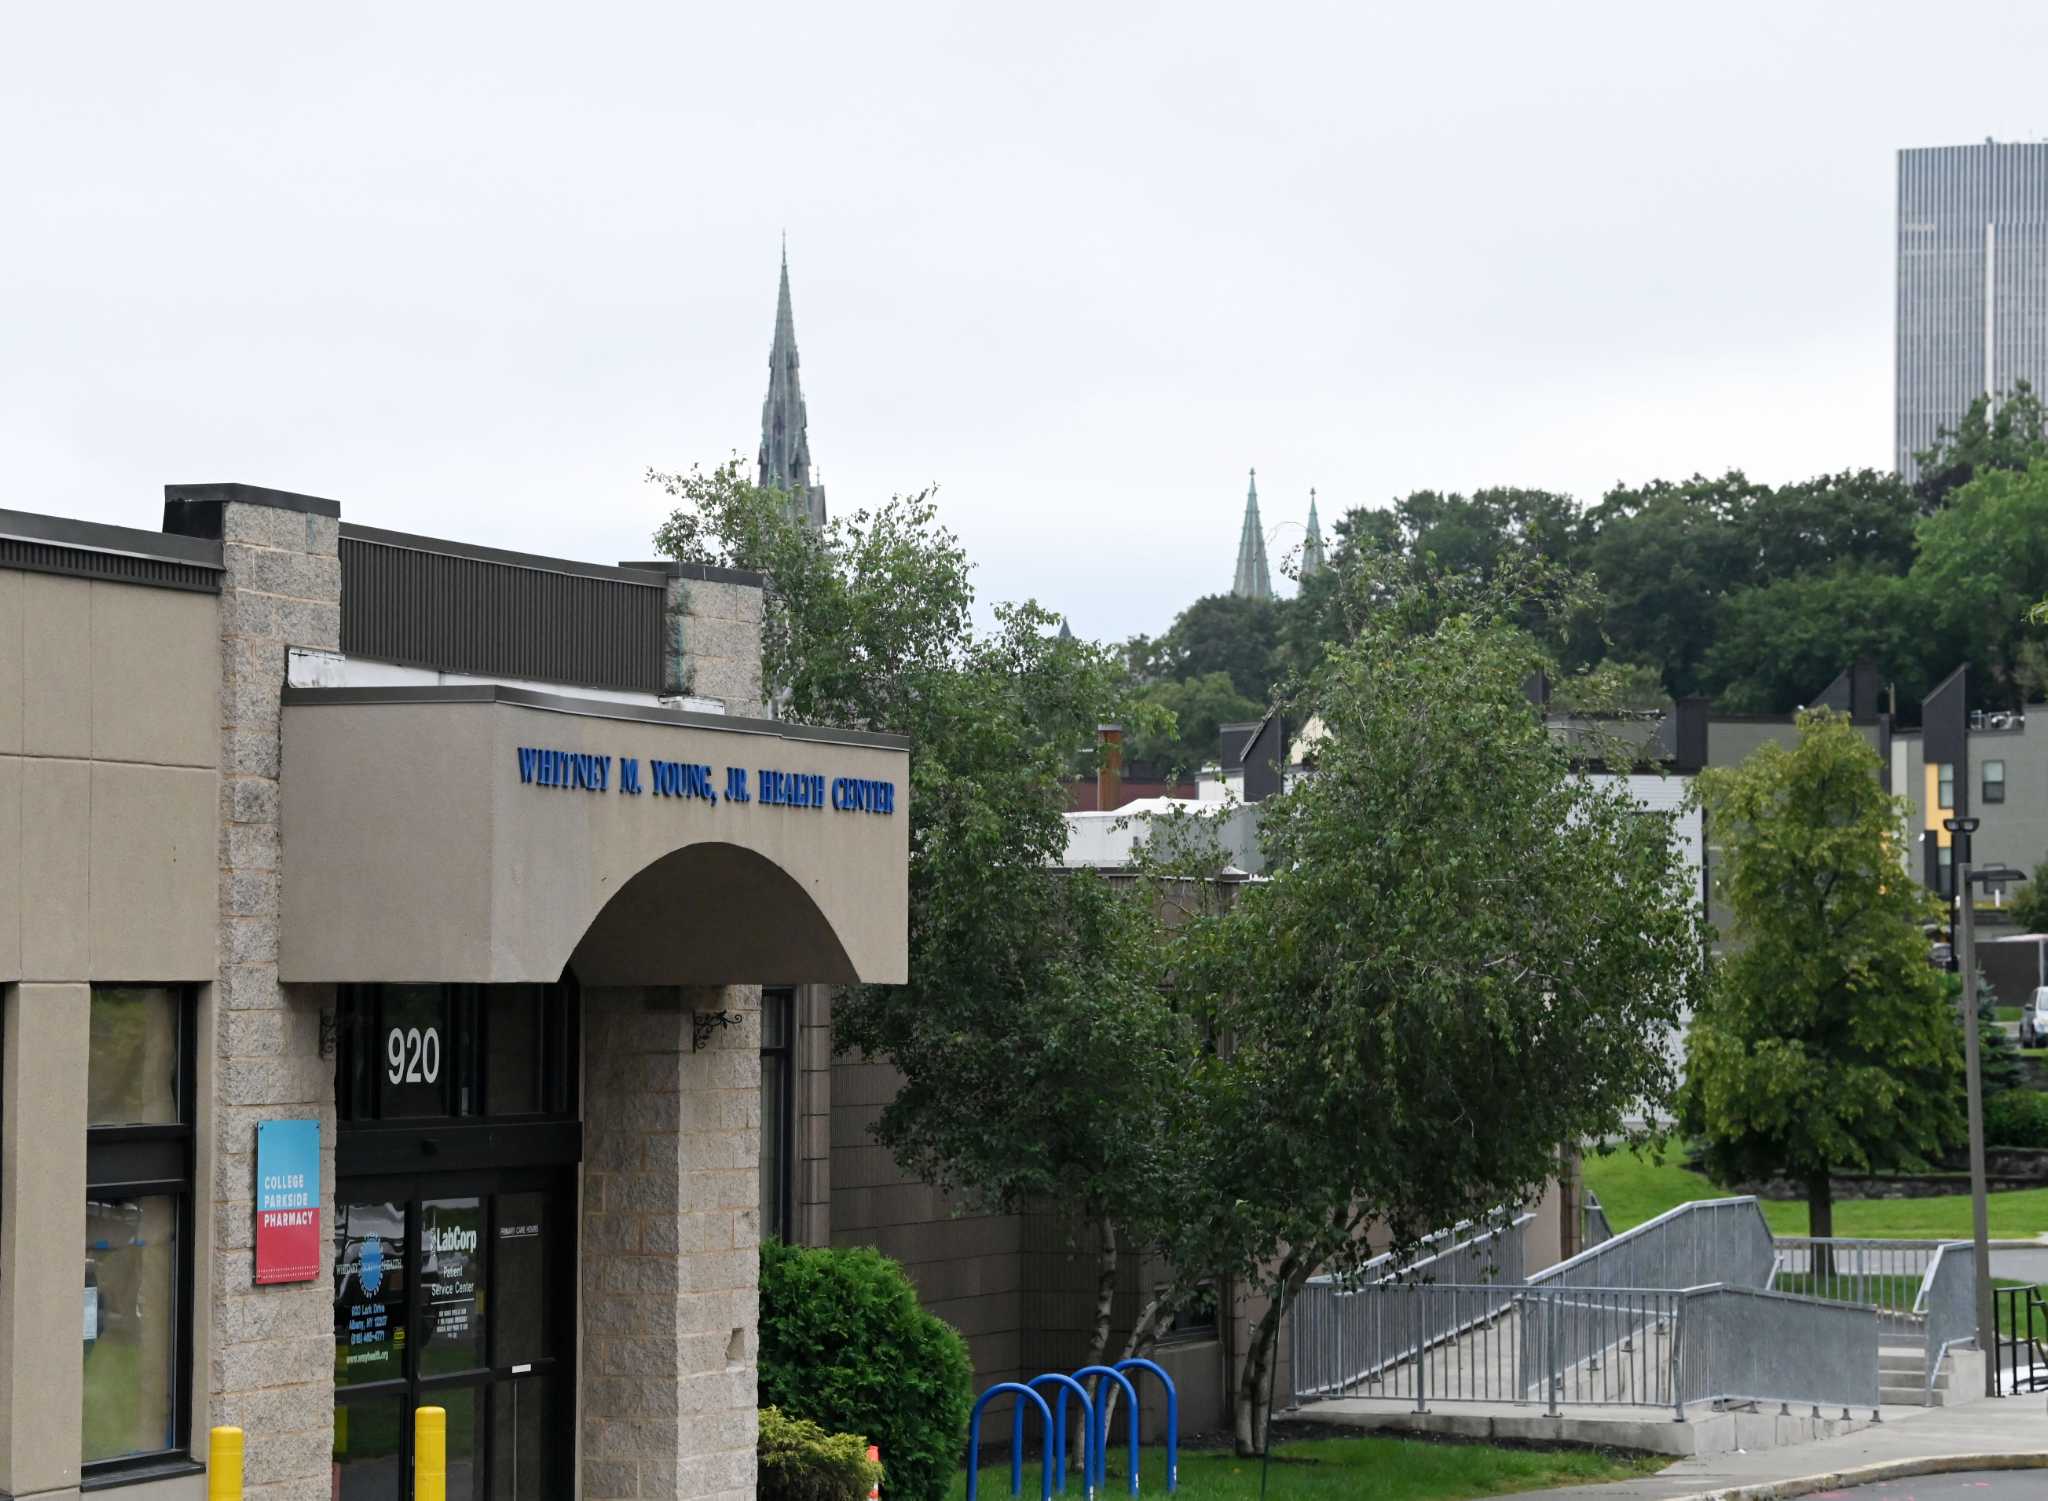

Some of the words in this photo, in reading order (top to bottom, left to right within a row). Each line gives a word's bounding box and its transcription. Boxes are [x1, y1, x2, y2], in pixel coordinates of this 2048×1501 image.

[517, 747, 612, 792] WHITNEY
[619, 757, 643, 795] M.
[650, 759, 719, 807] YOUNG,
[724, 766, 752, 803] JR.
[758, 769, 825, 809] HEALTH
[832, 776, 895, 815] CENTER
[388, 1027, 440, 1085] 920
[264, 1174, 304, 1190] COLLEGE
[264, 1192, 309, 1209] PARKSIDE
[264, 1210, 313, 1228] PHARMACY
[436, 1225, 477, 1254] LabCorp
[431, 1283, 453, 1296] Service
[454, 1282, 474, 1294] Center
